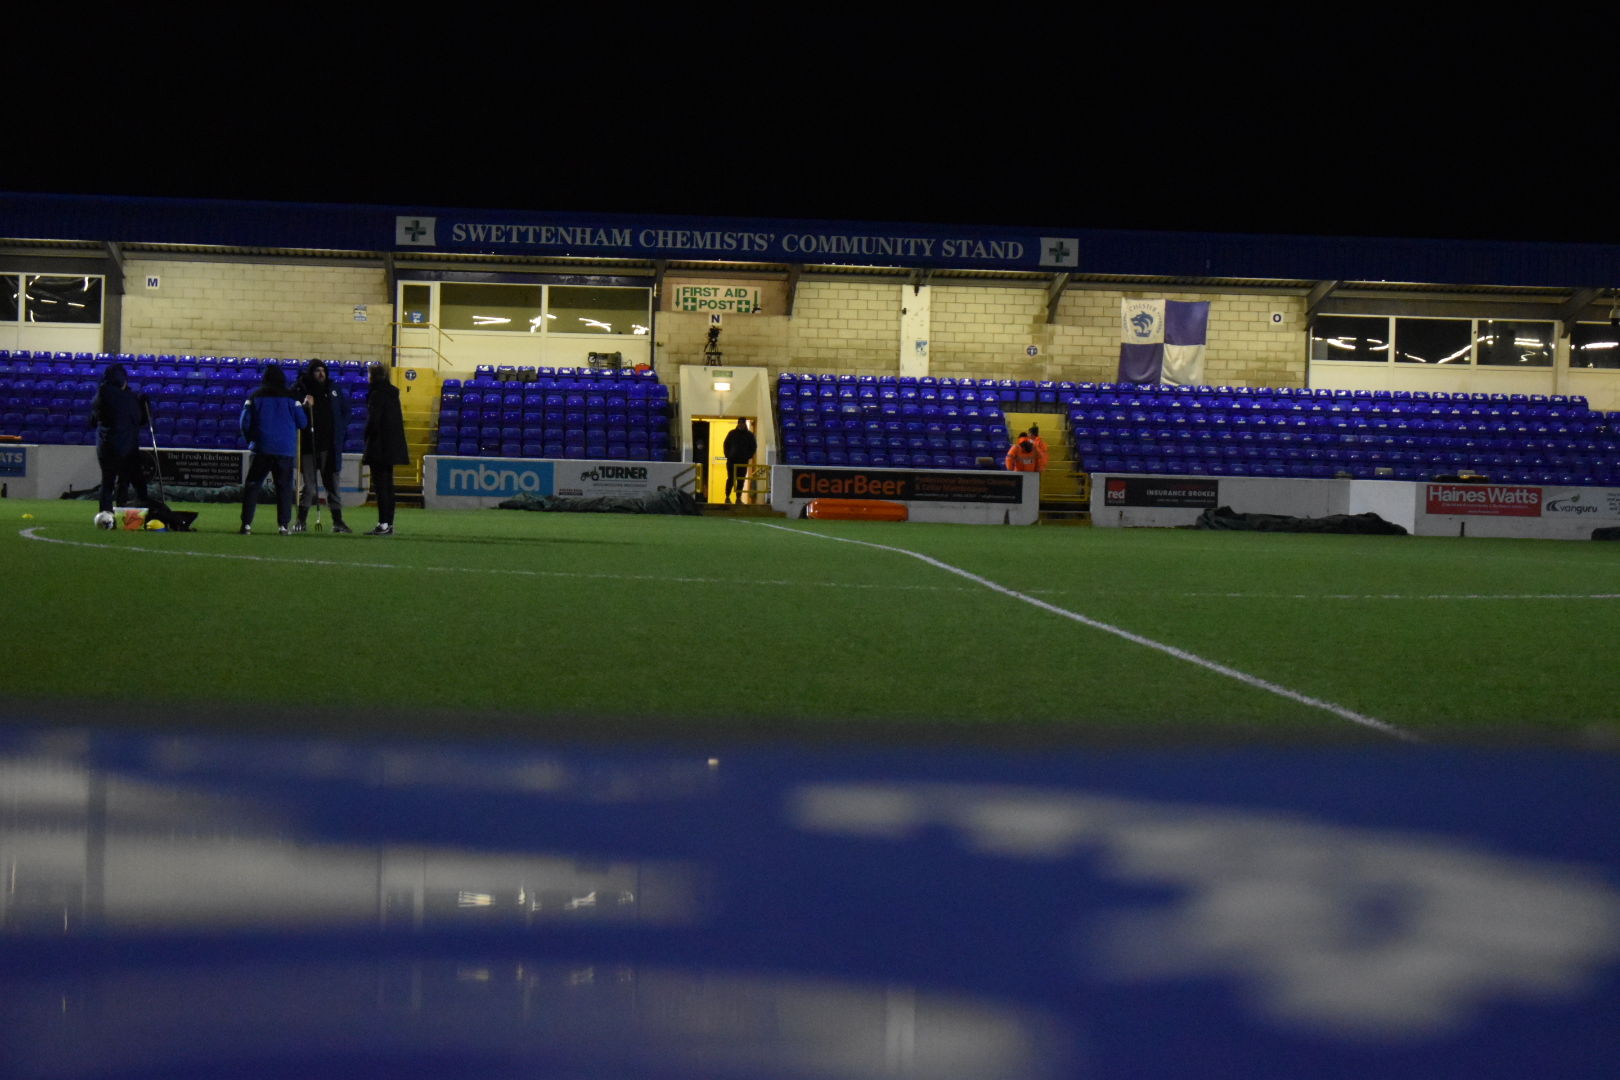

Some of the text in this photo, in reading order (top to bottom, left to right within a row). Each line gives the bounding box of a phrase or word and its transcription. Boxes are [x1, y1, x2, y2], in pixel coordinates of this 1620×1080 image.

[452, 223, 632, 247] SWETTENHAM
[782, 234, 935, 257] COMMUNITY
[941, 239, 1024, 260] STAND
[147, 277, 158, 287] M
[682, 286, 748, 298] FIRST AID
[698, 300, 735, 310] POST
[1128, 303, 1157, 312] CHESTER
[711, 314, 720, 323] N
[1273, 313, 1282, 323] O
[449, 463, 540, 491] mbna
[598, 466, 648, 479] TURNER
[795, 472, 906, 495] ClearBeer
[1107, 488, 1126, 499] red
[1146, 489, 1216, 498] INSURANCE BROKER
[1429, 486, 1539, 504] Haines Watts
[1560, 505, 1598, 514] vanguru
